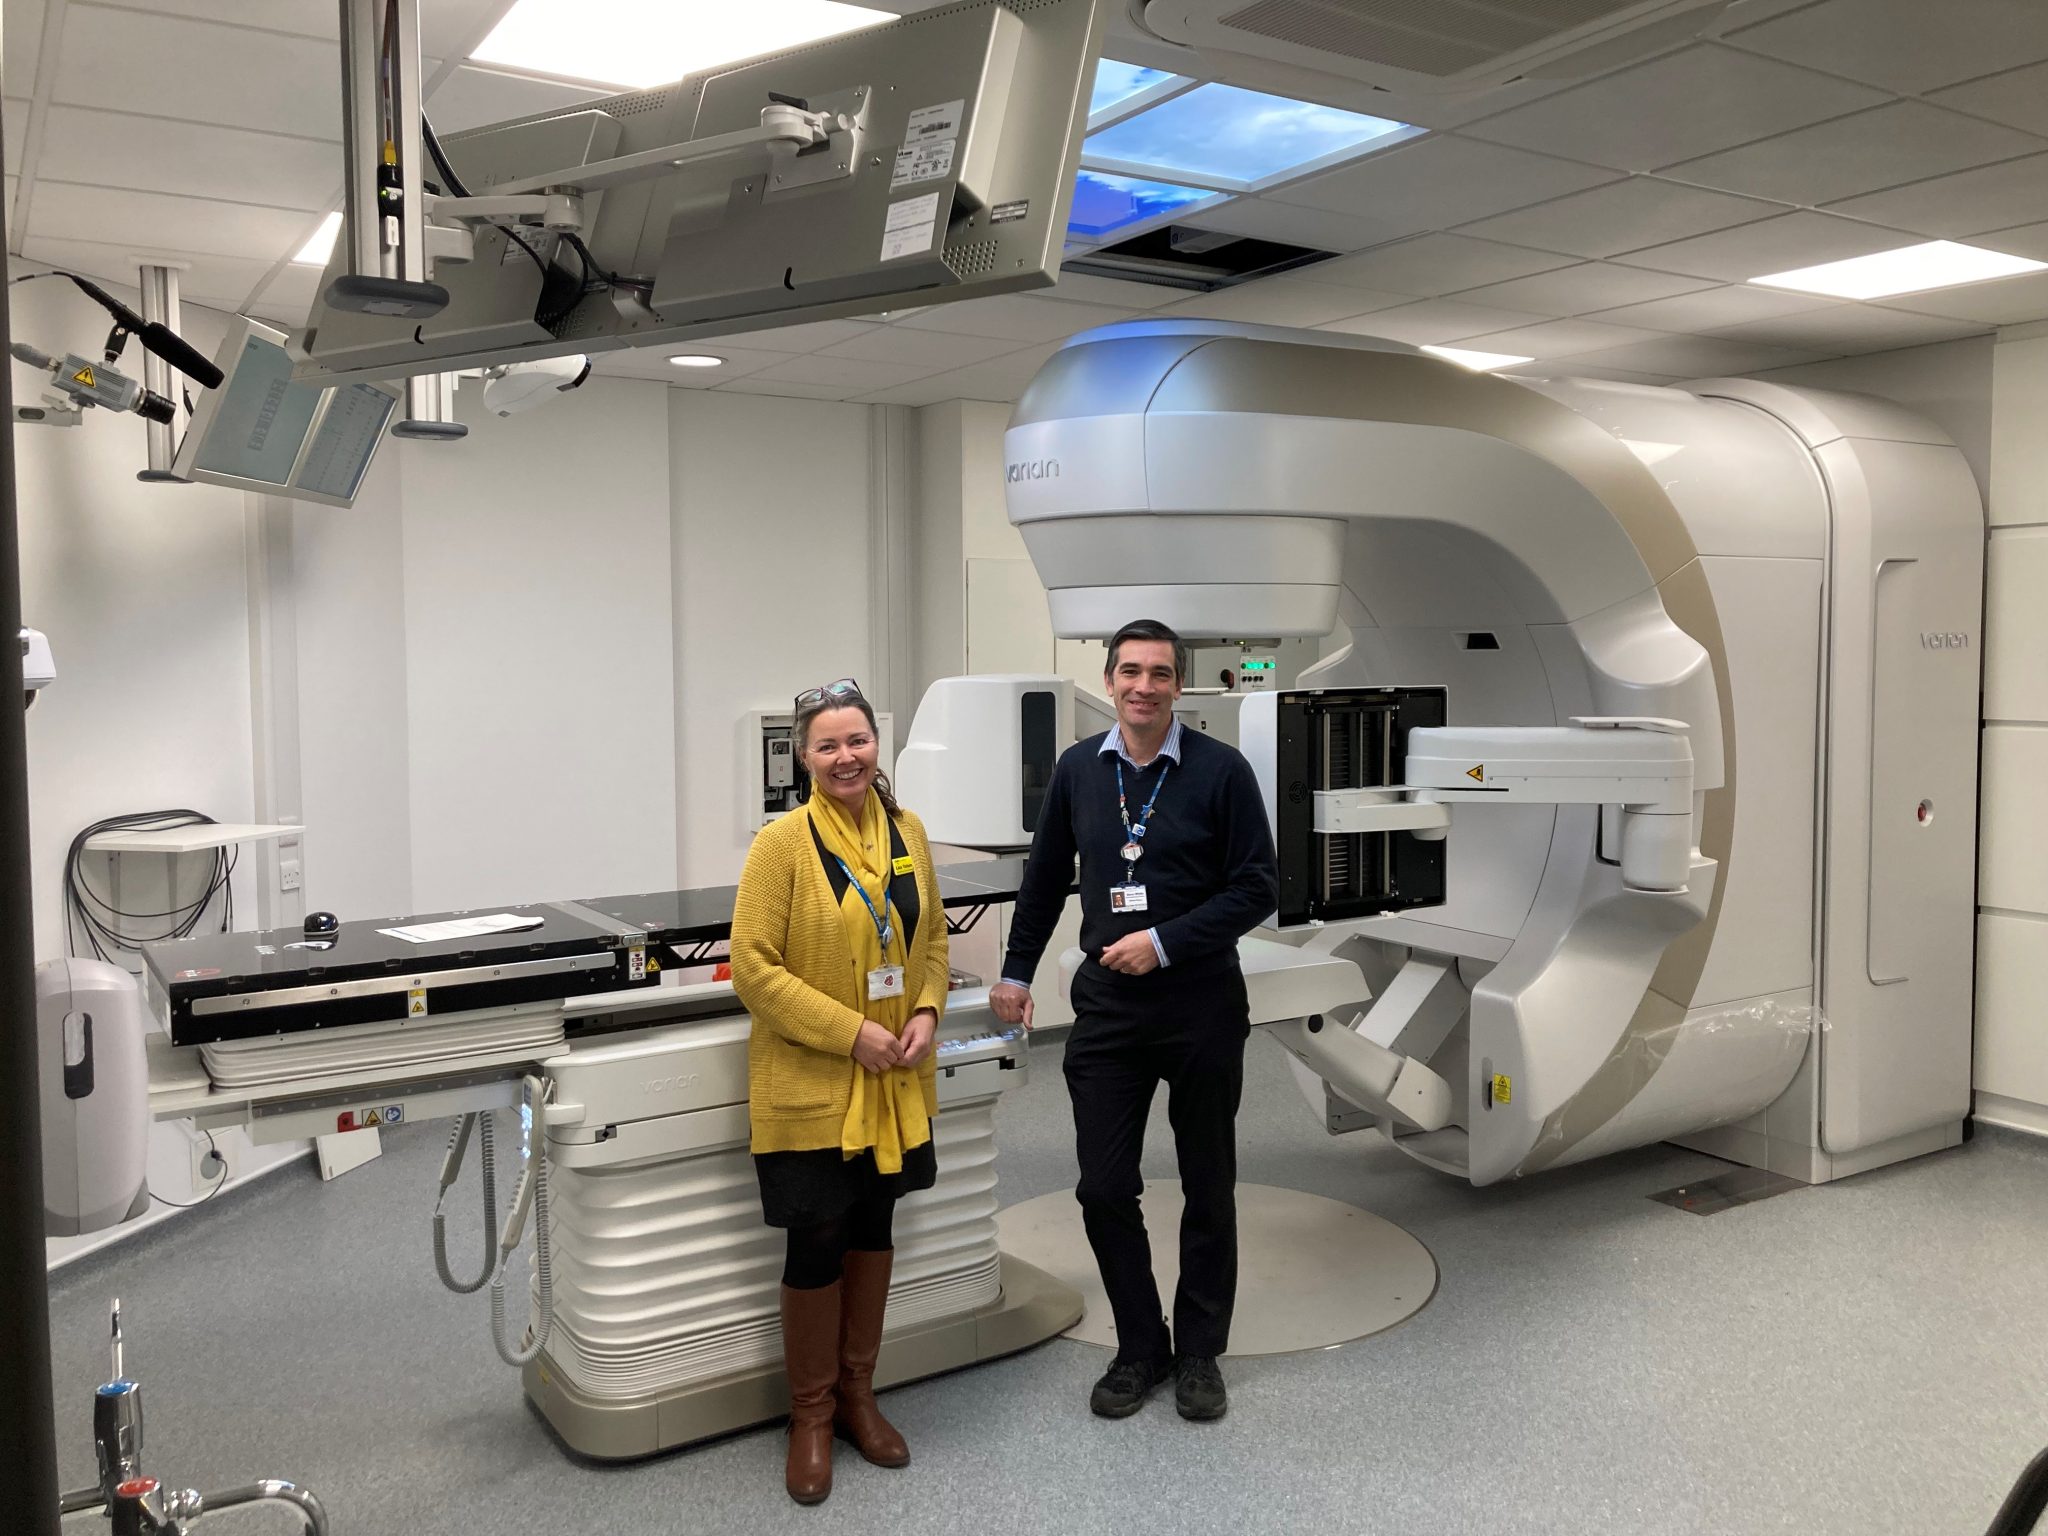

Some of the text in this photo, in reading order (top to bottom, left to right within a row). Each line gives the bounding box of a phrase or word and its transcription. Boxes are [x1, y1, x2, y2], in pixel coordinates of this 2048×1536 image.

[1005, 459, 1060, 483] varian
[1920, 632, 1968, 649] varian
[640, 1073, 699, 1095] varian
